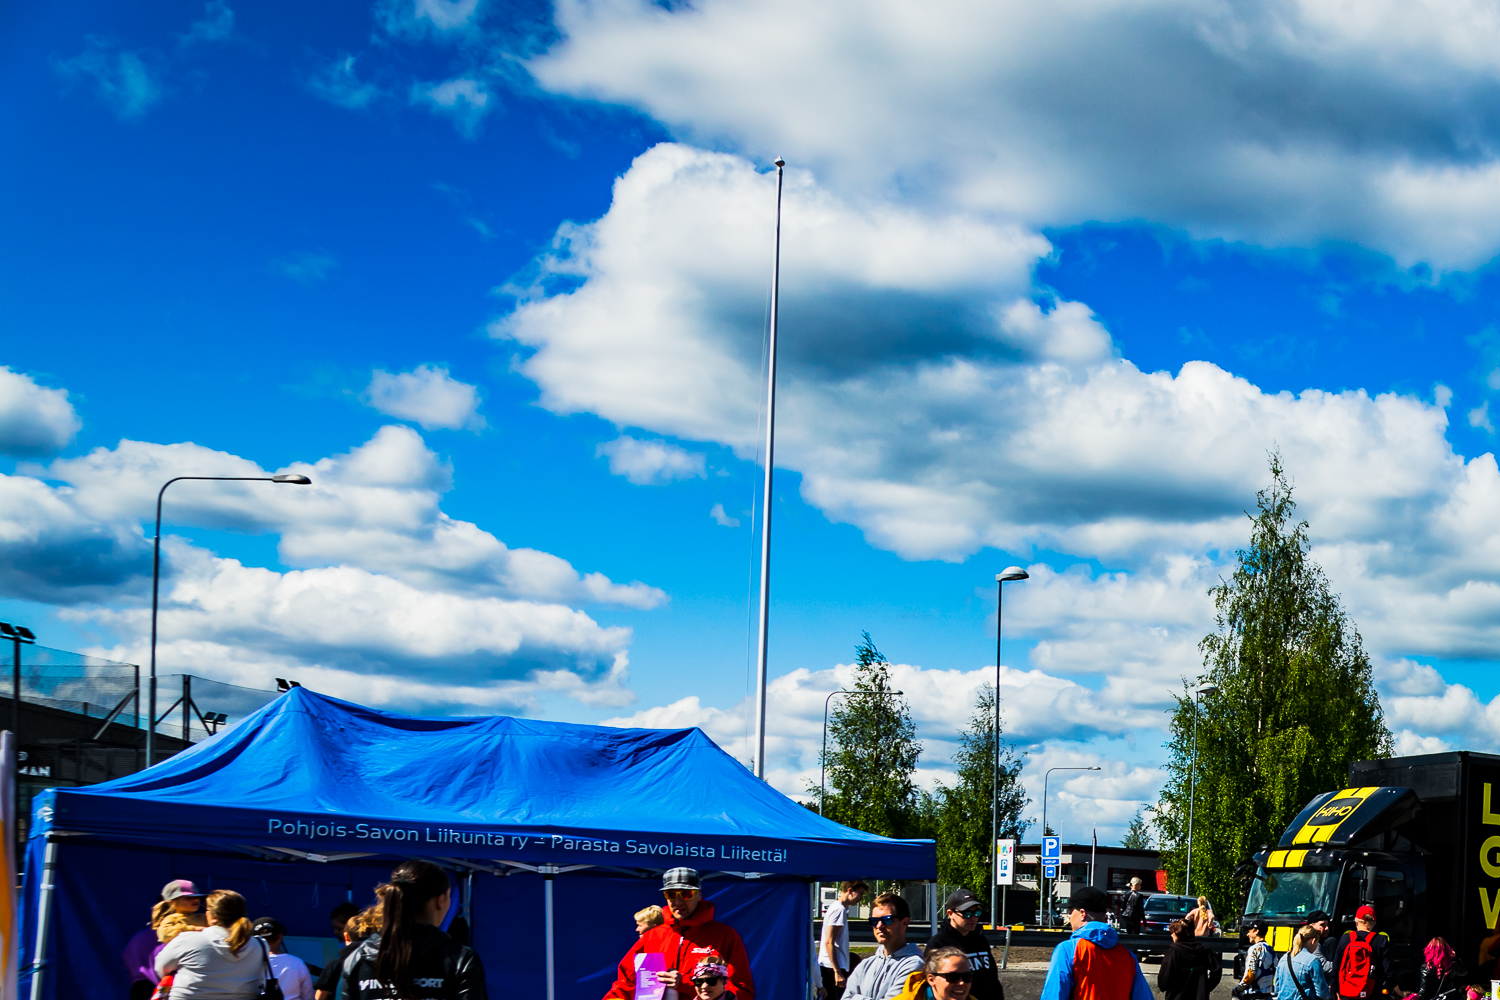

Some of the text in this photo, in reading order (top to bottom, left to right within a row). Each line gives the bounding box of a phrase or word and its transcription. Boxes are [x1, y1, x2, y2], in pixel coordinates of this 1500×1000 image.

[1315, 806, 1352, 817] KIHO
[268, 818, 418, 842] Pohjois-Savon
[426, 827, 504, 846] Liikunta
[510, 833, 528, 850] ry
[550, 834, 620, 853] Parasta
[626, 839, 715, 858] Savolaista
[721, 845, 787, 862] Liikettä!
[1045, 838, 1058, 857] P
[967, 955, 990, 972] ANS
